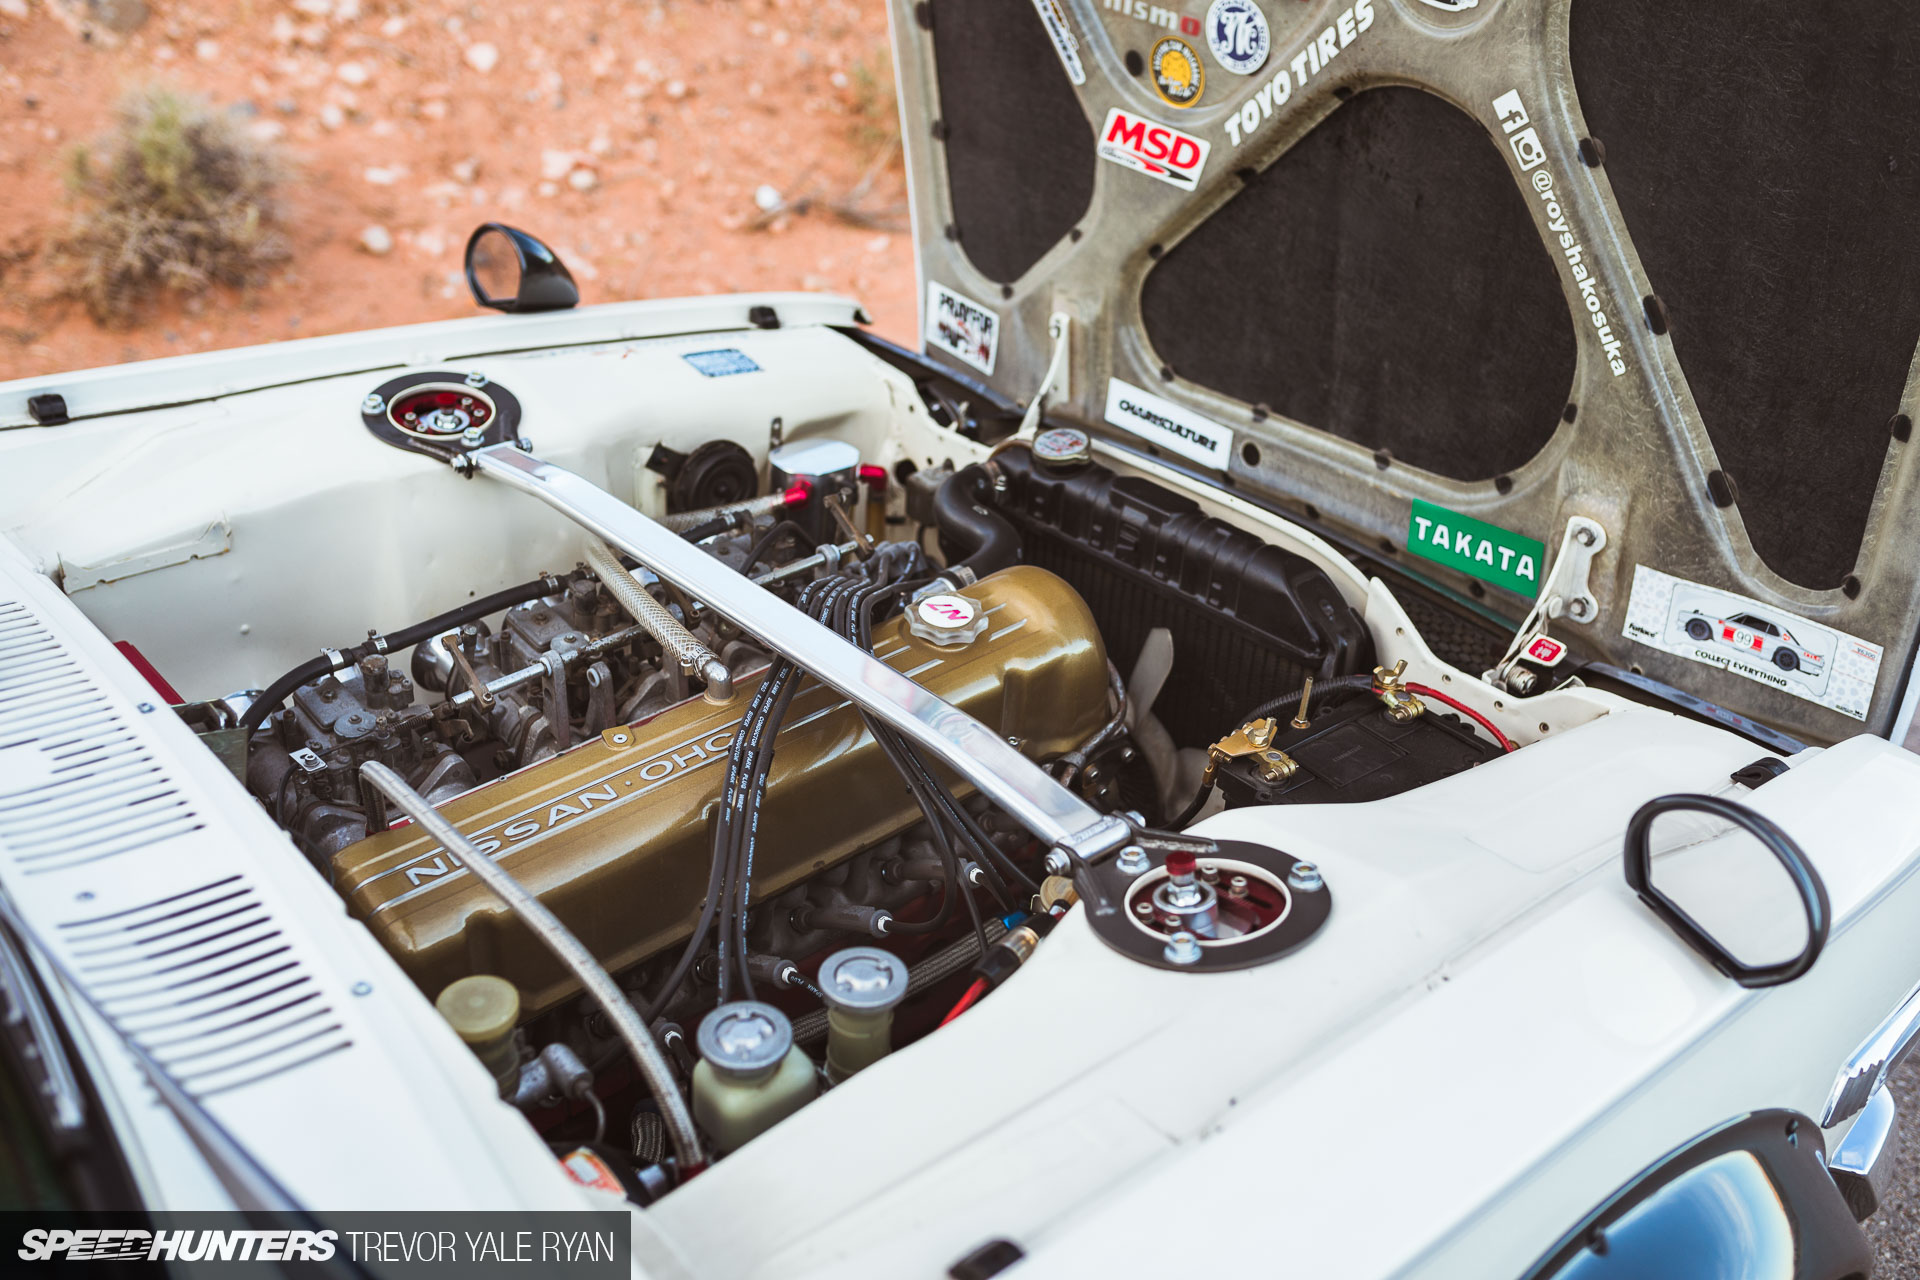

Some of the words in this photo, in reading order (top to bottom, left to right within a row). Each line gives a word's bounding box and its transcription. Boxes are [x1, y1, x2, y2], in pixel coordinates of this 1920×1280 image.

[1223, 69, 1293, 147] TOYO
[1290, 0, 1375, 87] TIRES
[1106, 114, 1201, 170] MSD
[1531, 170, 1627, 378] @royshakosuka
[1414, 515, 1537, 582] TAKATA
[1694, 649, 1731, 666] COLLECT
[1733, 661, 1788, 687] EVERYTHING
[639, 732, 735, 781] OHC
